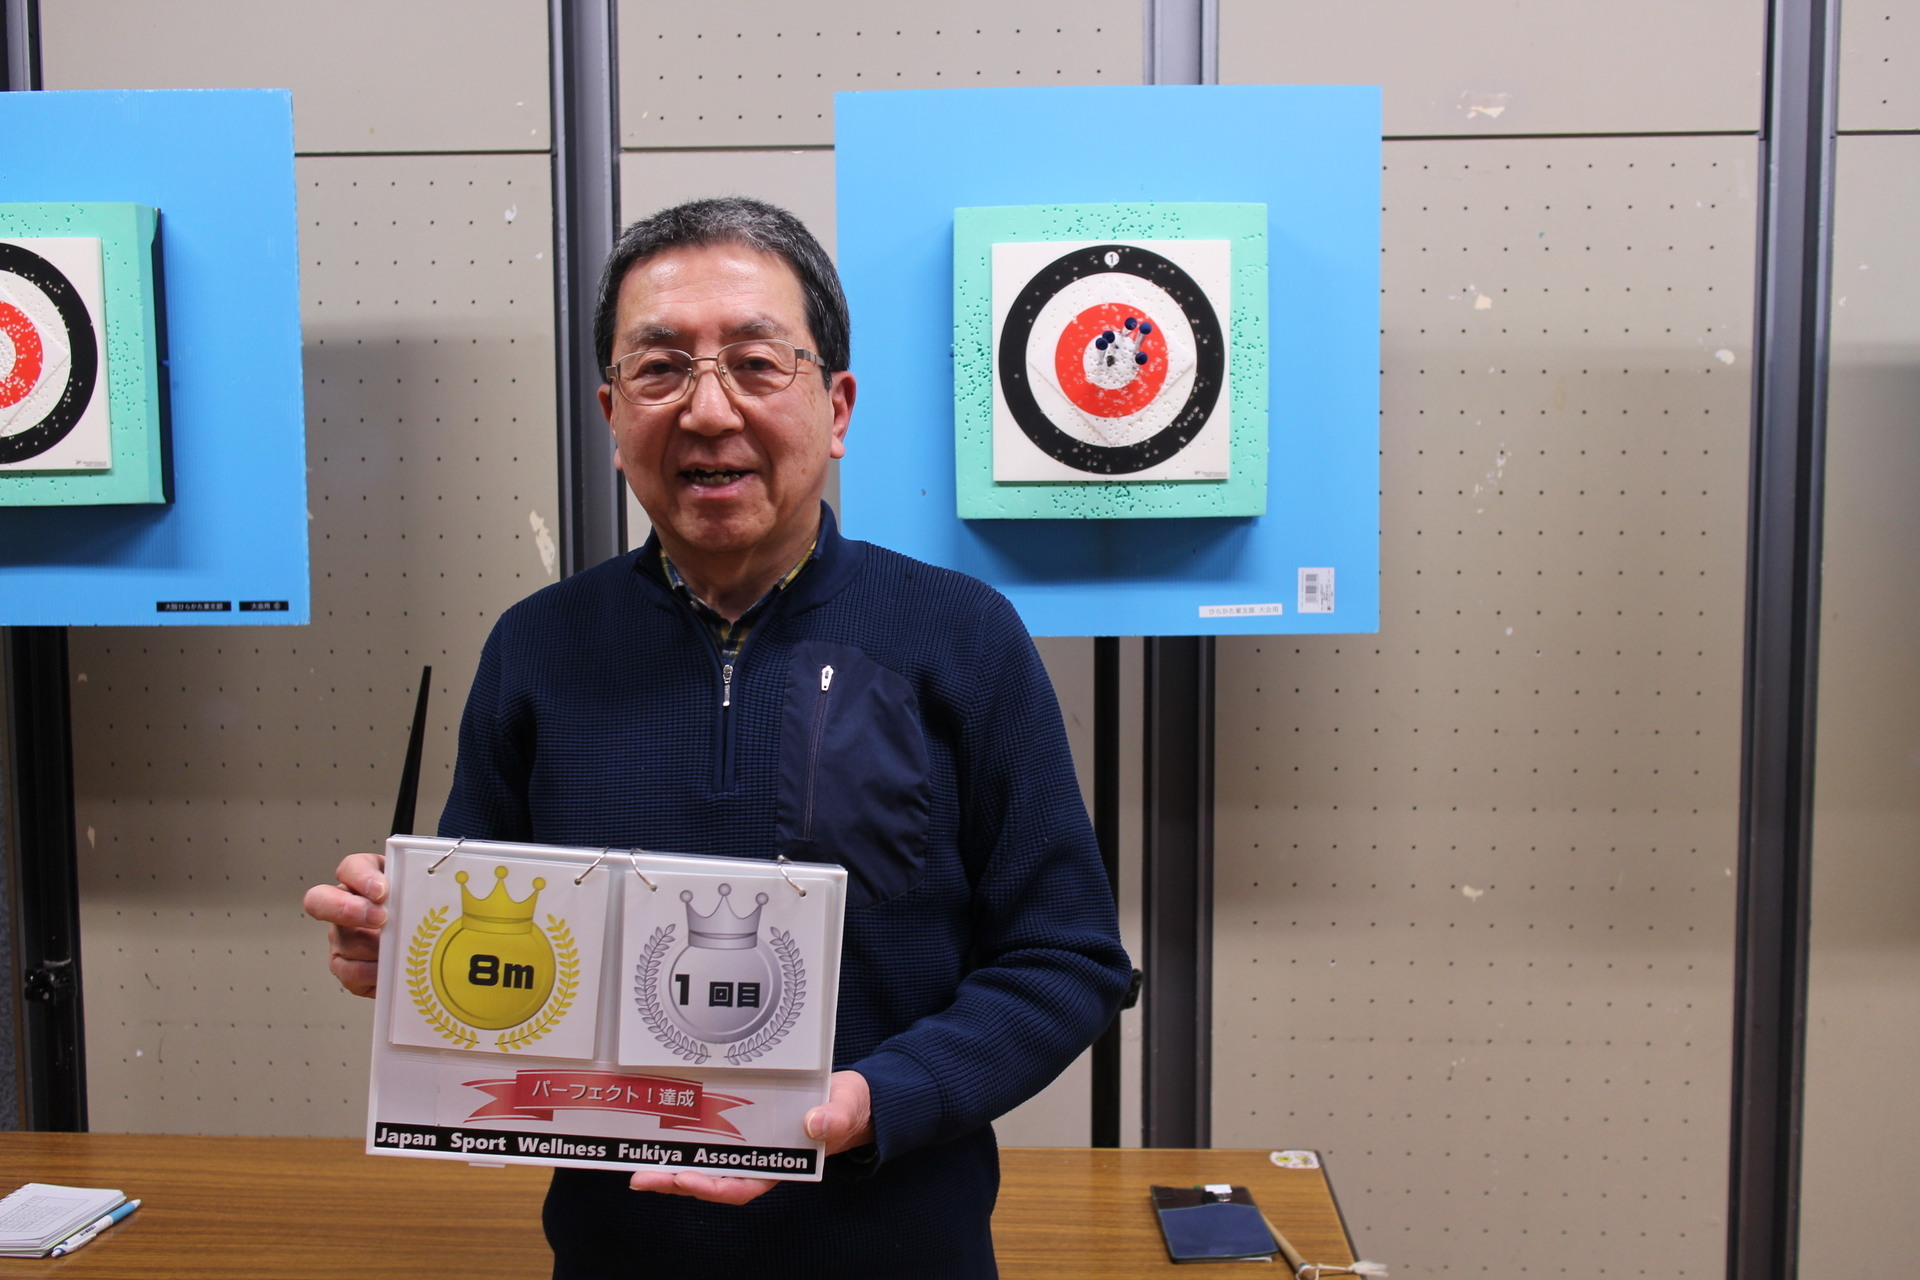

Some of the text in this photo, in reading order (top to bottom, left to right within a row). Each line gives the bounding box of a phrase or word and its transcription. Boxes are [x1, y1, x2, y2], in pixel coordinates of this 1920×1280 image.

[468, 954, 535, 990] 8m
[376, 1127, 808, 1169] Japan Sport Wellness Fukiya Association
